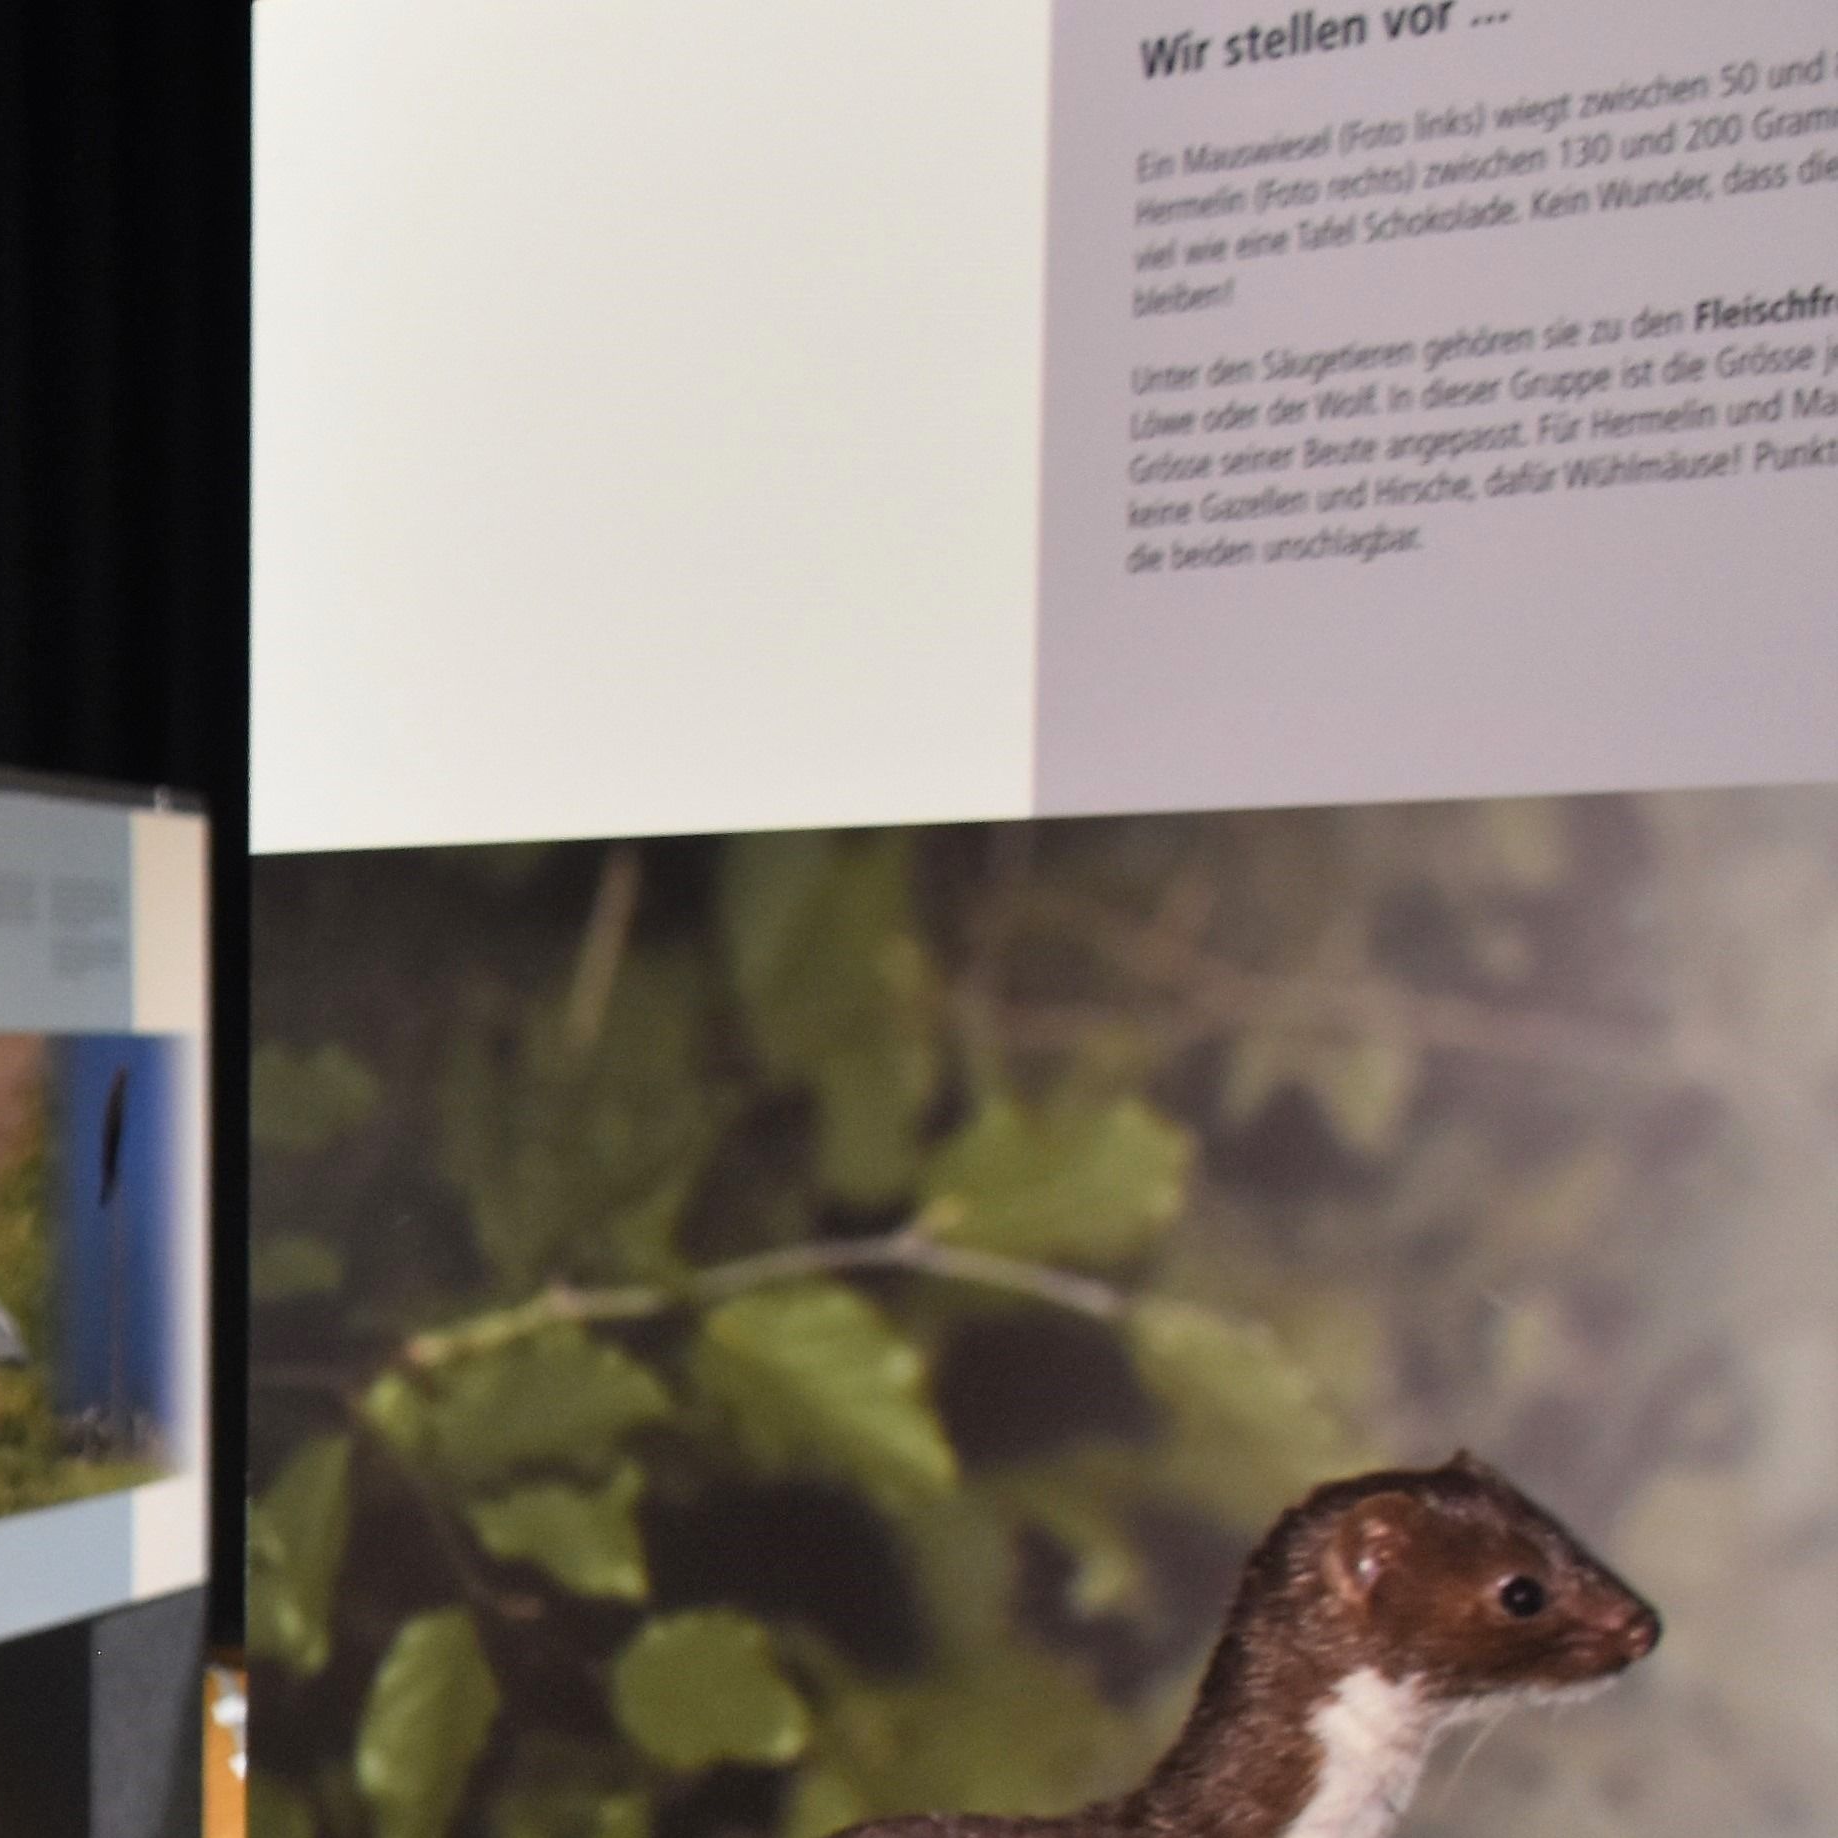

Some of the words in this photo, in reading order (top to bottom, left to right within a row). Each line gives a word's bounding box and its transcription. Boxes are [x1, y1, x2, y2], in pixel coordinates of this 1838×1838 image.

[1137, 31, 1213, 78] Wir
[1224, 10, 1371, 66] stellen
[1382, 0, 1457, 39] vor
[1136, 150, 1175, 183] Ein
[1182, 128, 1332, 174] Mauswiesel
[1339, 120, 1406, 153] (Foto
[1413, 104, 1487, 141] links)
[1494, 93, 1571, 129] wiegt
[1580, 75, 1710, 118] zwischen
[1721, 59, 1759, 98] 50
[1768, 50, 1827, 90] und
[1133, 187, 1248, 225] Hermelin
[1252, 178, 1321, 213] (Foto
[1326, 161, 1418, 199] rechts)
[1423, 147, 1549, 188] zwischen
[1560, 131, 1614, 168] 130
[1619, 122, 1679, 161] und
[1687, 112, 1745, 152] 200
[1135, 240, 1174, 271] viel
[1186, 237, 1226, 265] wie
[1237, 230, 1288, 260] eine
[1300, 215, 1355, 251] Tafel
[1366, 196, 1520, 242] Schokolade.
[1531, 188, 1589, 220] Kein
[1597, 171, 1713, 210] Wunder,
[1725, 161, 1787, 195] dass
[1132, 279, 1235, 316] bleiben!
[1130, 410, 1195, 441] Löwe
[1203, 400, 1258, 433] oder
[1268, 396, 1307, 426] der
[1315, 383, 1377, 419] Wolf.
[1388, 385, 1412, 412] In
[1422, 378, 1499, 410] dieser
[1511, 366, 1613, 402] Gruppe
[1621, 358, 1654, 389] ist
[1663, 350, 1706, 385] die
[1716, 343, 1815, 378] Grösse
[1133, 366, 1196, 394] Unter
[1211, 358, 1251, 387] den
[1265, 341, 1414, 383] Säugetieren
[1426, 327, 1533, 371] gehören
[1546, 322, 1579, 350] sie
[1592, 318, 1621, 345] zu
[1633, 308, 1682, 339] den
[1129, 452, 1213, 484] Grösse
[1221, 446, 1294, 476] seiner
[1302, 436, 1378, 468] Beute
[1387, 426, 1527, 466] angepasst.
[1537, 411, 1580, 444] Für
[1590, 399, 1717, 438] Hermelin
[1726, 390, 1784, 427] und
[1127, 500, 1192, 529] keine
[1200, 486, 1308, 523] Gazellen
[1317, 478, 1368, 513] und
[1374, 472, 1475, 506] Hirsche,
[1485, 461, 1556, 497] dafür
[1564, 446, 1742, 488] Wühlmäuse!
[1127, 545, 1164, 574] die
[1171, 537, 1255, 571] beiden
[1263, 521, 1426, 565] unschlagbar.
